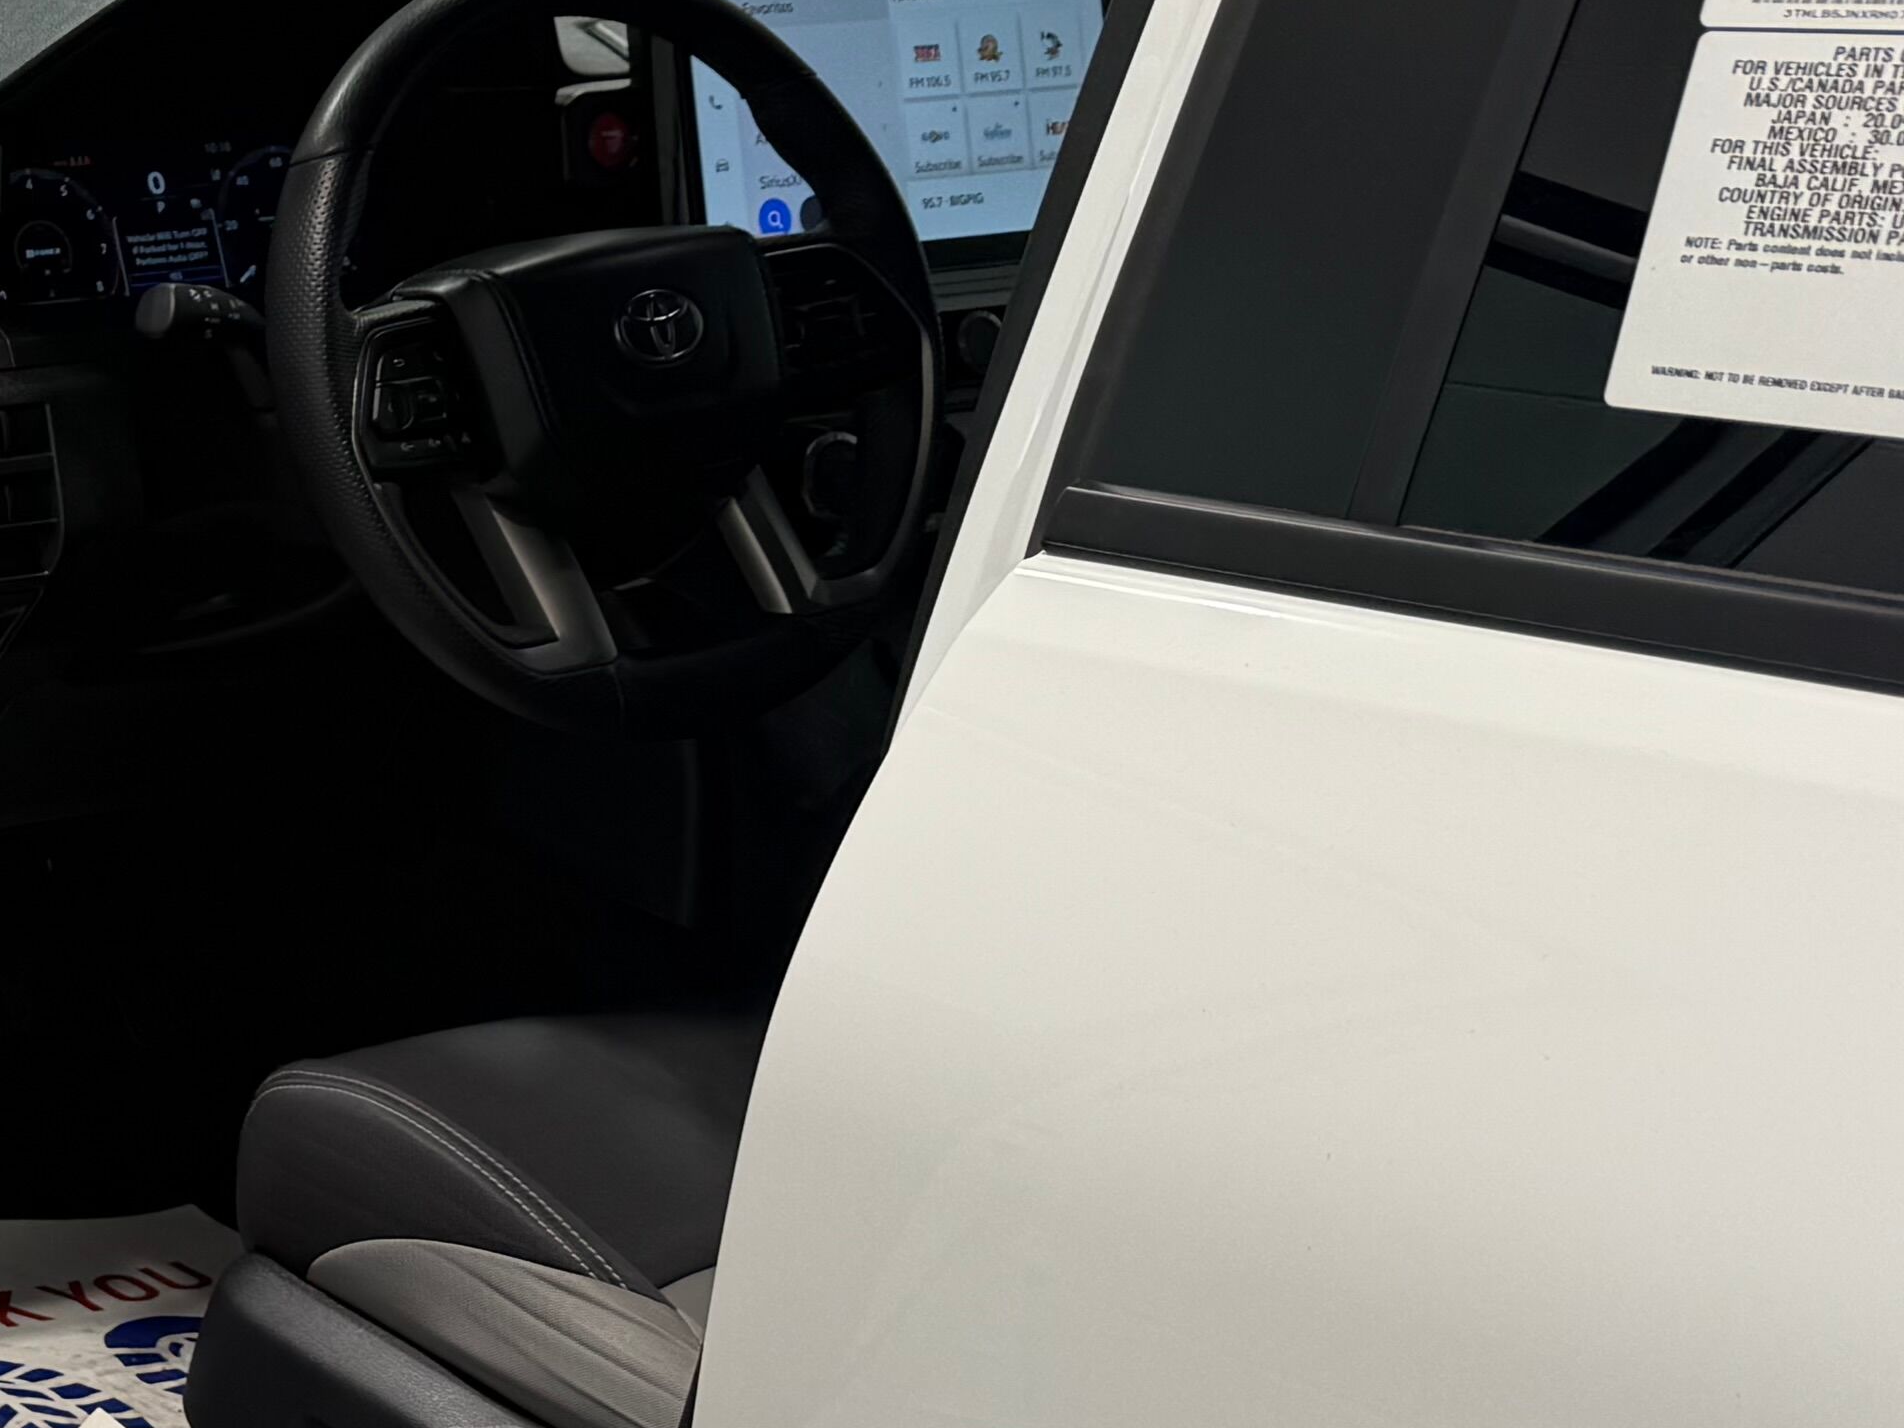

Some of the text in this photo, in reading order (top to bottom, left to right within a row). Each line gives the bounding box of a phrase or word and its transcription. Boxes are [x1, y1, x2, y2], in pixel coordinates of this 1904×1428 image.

[1833, 46, 1895, 62] PARTS
[1732, 59, 1767, 75] FOR
[1773, 61, 1859, 77] VEHICLES
[1864, 63, 1885, 79] IN
[1749, 76, 1865, 94] U.S./CANADA
[1743, 92, 1898, 112] MAJOR SOURCES
[1771, 110, 1832, 126] JAPAN
[1767, 125, 1838, 143] MEXICO
[1710, 138, 1879, 160] FOR THIS VEHICLE:
[1726, 155, 1777, 172] FINAL
[1782, 158, 1885, 178] ASSEMBLY
[146, 170, 166, 195] 0
[1754, 172, 1800, 190] BAJA
[1718, 186, 1904, 212] COUNTRY OF ORIGIN
[1746, 204, 1812, 224] ENGINE
[1817, 208, 1885, 229] PARTS:
[1743, 220, 1880, 245] TRANSMISSION
[1684, 235, 1723, 250] NOTE:
[1726, 238, 1759, 253] Parts
[1815, 244, 1845, 258] does
[1850, 247, 1873, 260] not
[1679, 254, 1694, 265] or
[1697, 252, 1730, 266] other
[35, 1260, 213, 1314] YOU
